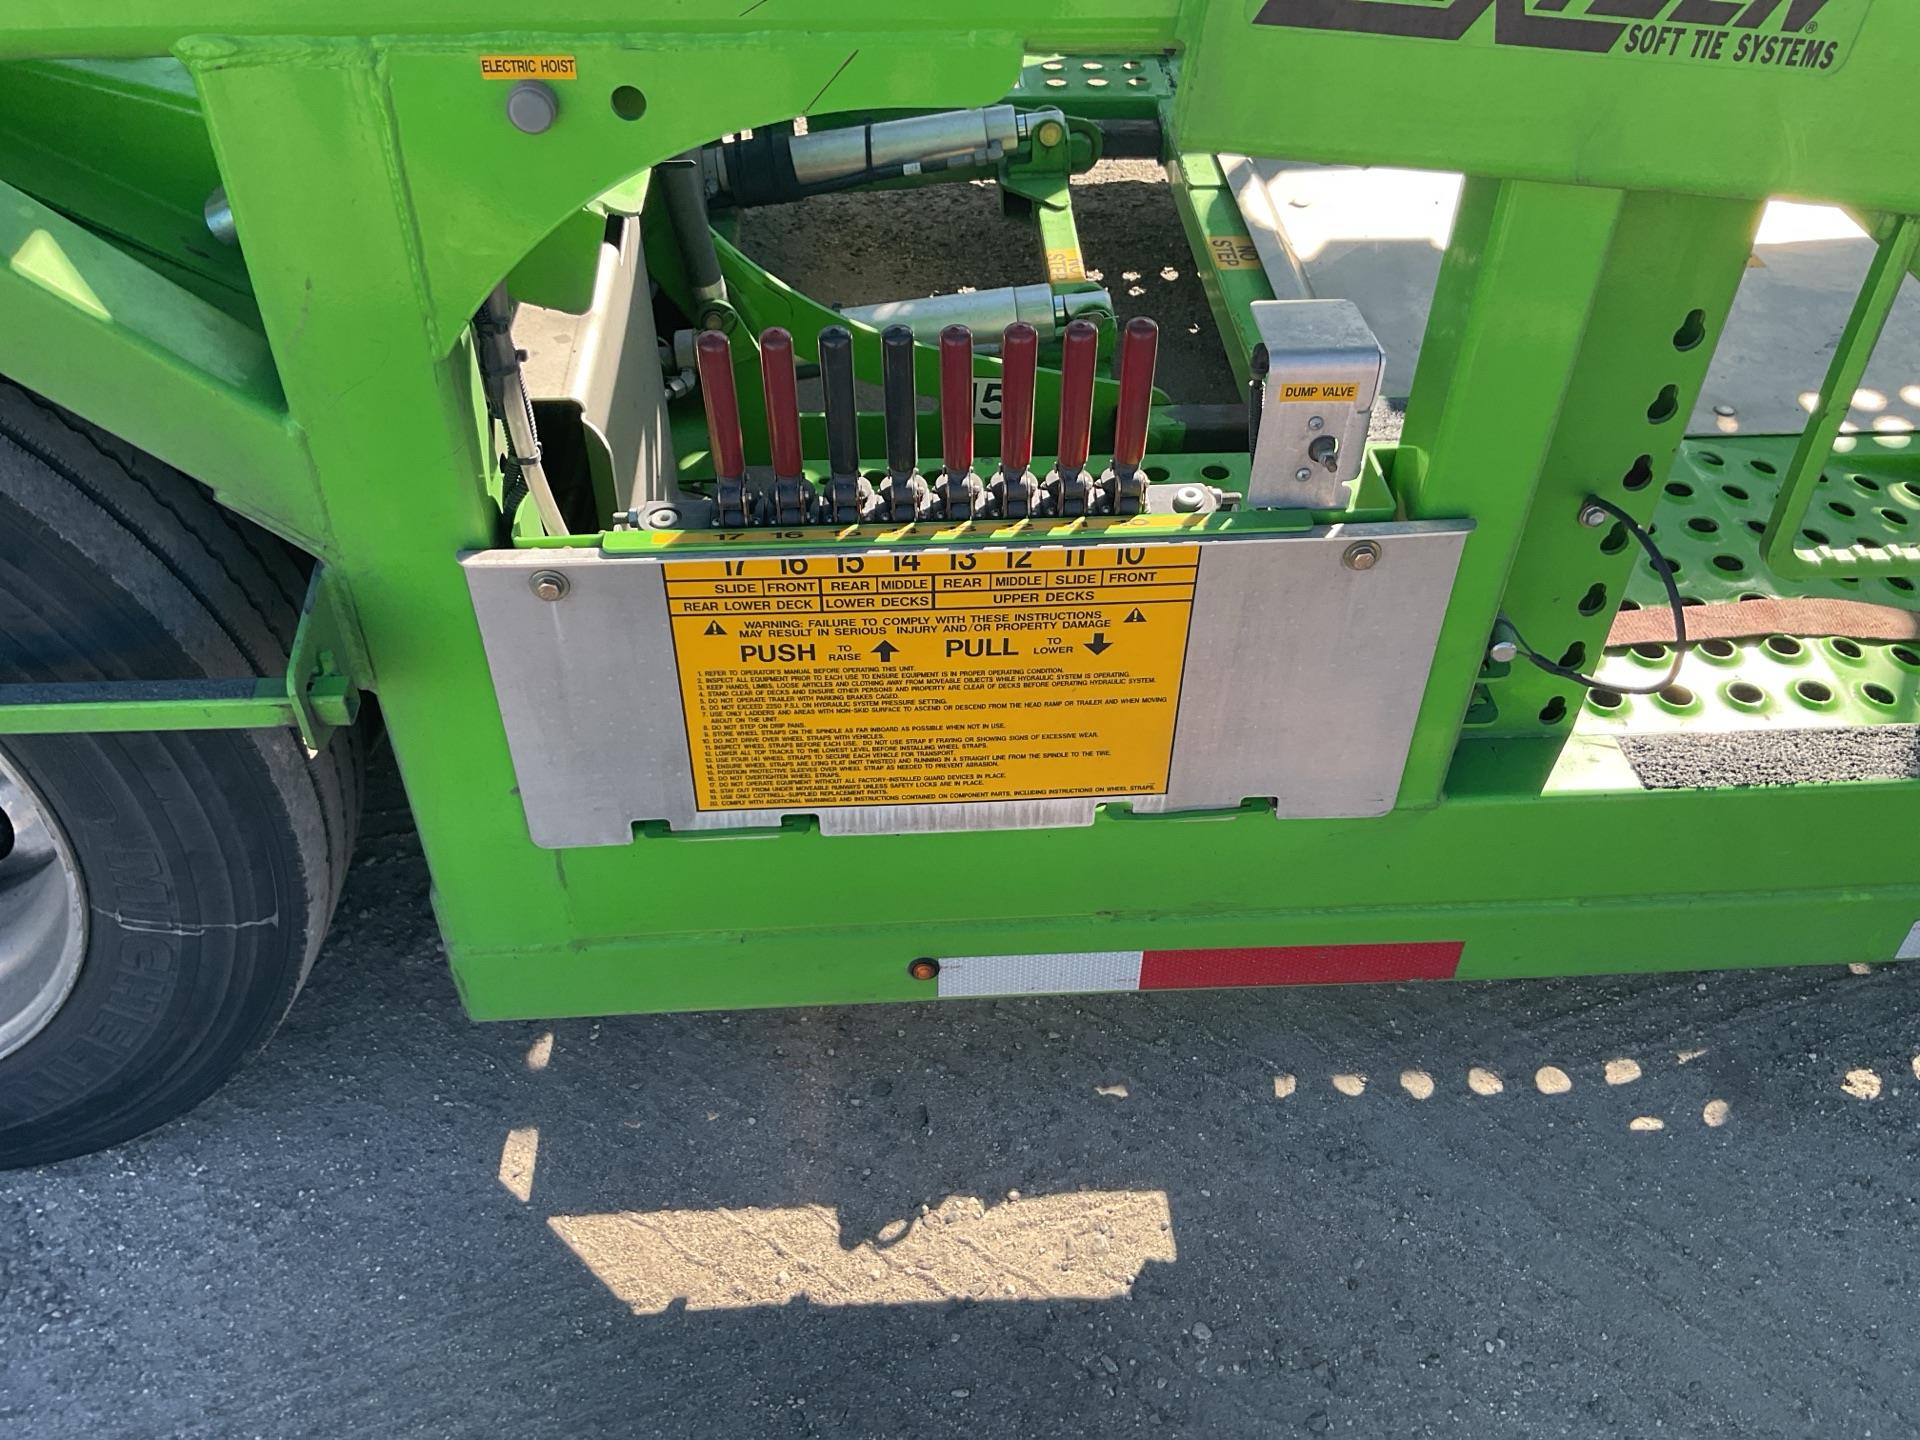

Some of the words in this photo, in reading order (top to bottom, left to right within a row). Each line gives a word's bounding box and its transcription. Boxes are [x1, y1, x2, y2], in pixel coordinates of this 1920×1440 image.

[1625, 24, 1687, 56] SOFT
[1690, 29, 1729, 60] TIE
[1732, 33, 1838, 69] SYSTEMS
[481, 59, 536, 73] ELECTRIC
[540, 59, 574, 73] HOIST
[1212, 239, 1240, 267] STEP
[1285, 386, 1318, 397] DUMP
[1322, 386, 1355, 397] VALVE
[943, 577, 982, 588] REAR
[995, 575, 1042, 587] MIDDLE
[1055, 574, 1096, 585] SLIDE
[1108, 571, 1158, 583] FRONT
[714, 582, 757, 595] SLIDE
[767, 581, 816, 593] FRONT
[830, 580, 870, 592] REAR
[880, 579, 928, 591] MIDDLE
[826, 597, 875, 609] LOWER
[881, 596, 929, 608] DECKS
[993, 592, 1039, 604] UPPER
[1046, 590, 1095, 602] DECKS
[683, 601, 718, 612] REAR
[724, 600, 770, 612] LOWER
[776, 599, 812, 610] DECK
[744, 620, 804, 630] WARNING:
[808, 618, 856, 628] FAILURE
[861, 618, 878, 627] TO
[882, 616, 930, 627] COMPLY
[936, 614, 966, 624] WITH
[970, 613, 1010, 623] THESE
[1014, 611, 1102, 622] INSTRUCTIONS
[739, 630, 763, 640] MAY
[768, 628, 812, 638] RESULT
[818, 628, 830, 637] IN
[834, 626, 886, 636] SERIOUS
[896, 624, 938, 635] INJURY
[943, 623, 991, 634] AND/OR
[996, 622, 1058, 632] PROPERTY
[1062, 619, 1112, 630] DAMAGE
[1047, 637, 1062, 645] TO
[740, 643, 816, 664] PUSH
[838, 644, 852, 653] TO
[945, 638, 1018, 658] PULL
[1033, 646, 1074, 655] LOWER
[828, 652, 862, 662] RAISE
